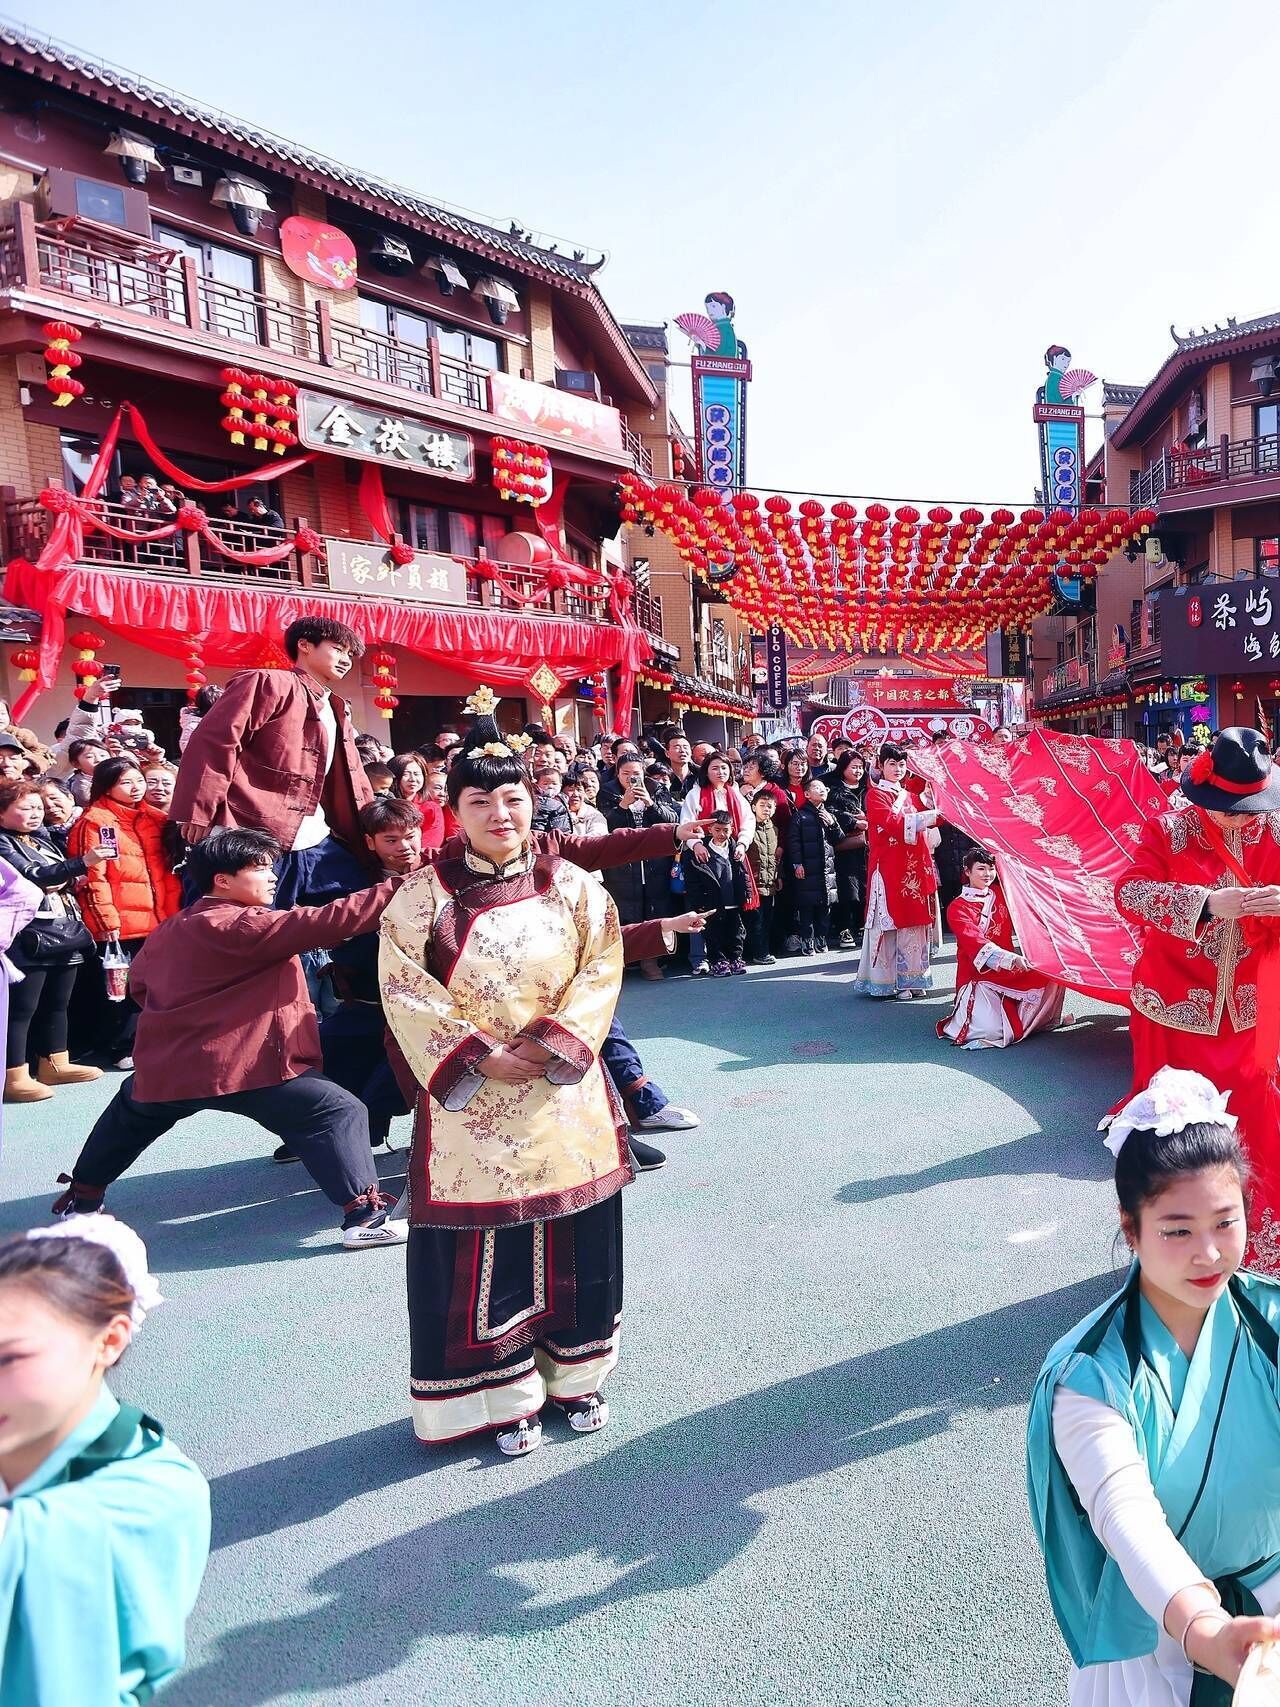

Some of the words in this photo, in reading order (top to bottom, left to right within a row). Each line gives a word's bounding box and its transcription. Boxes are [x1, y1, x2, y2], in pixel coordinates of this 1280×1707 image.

[772, 656, 782, 705] COFFEE
[872, 688, 950, 702] 中国茯茶之都
